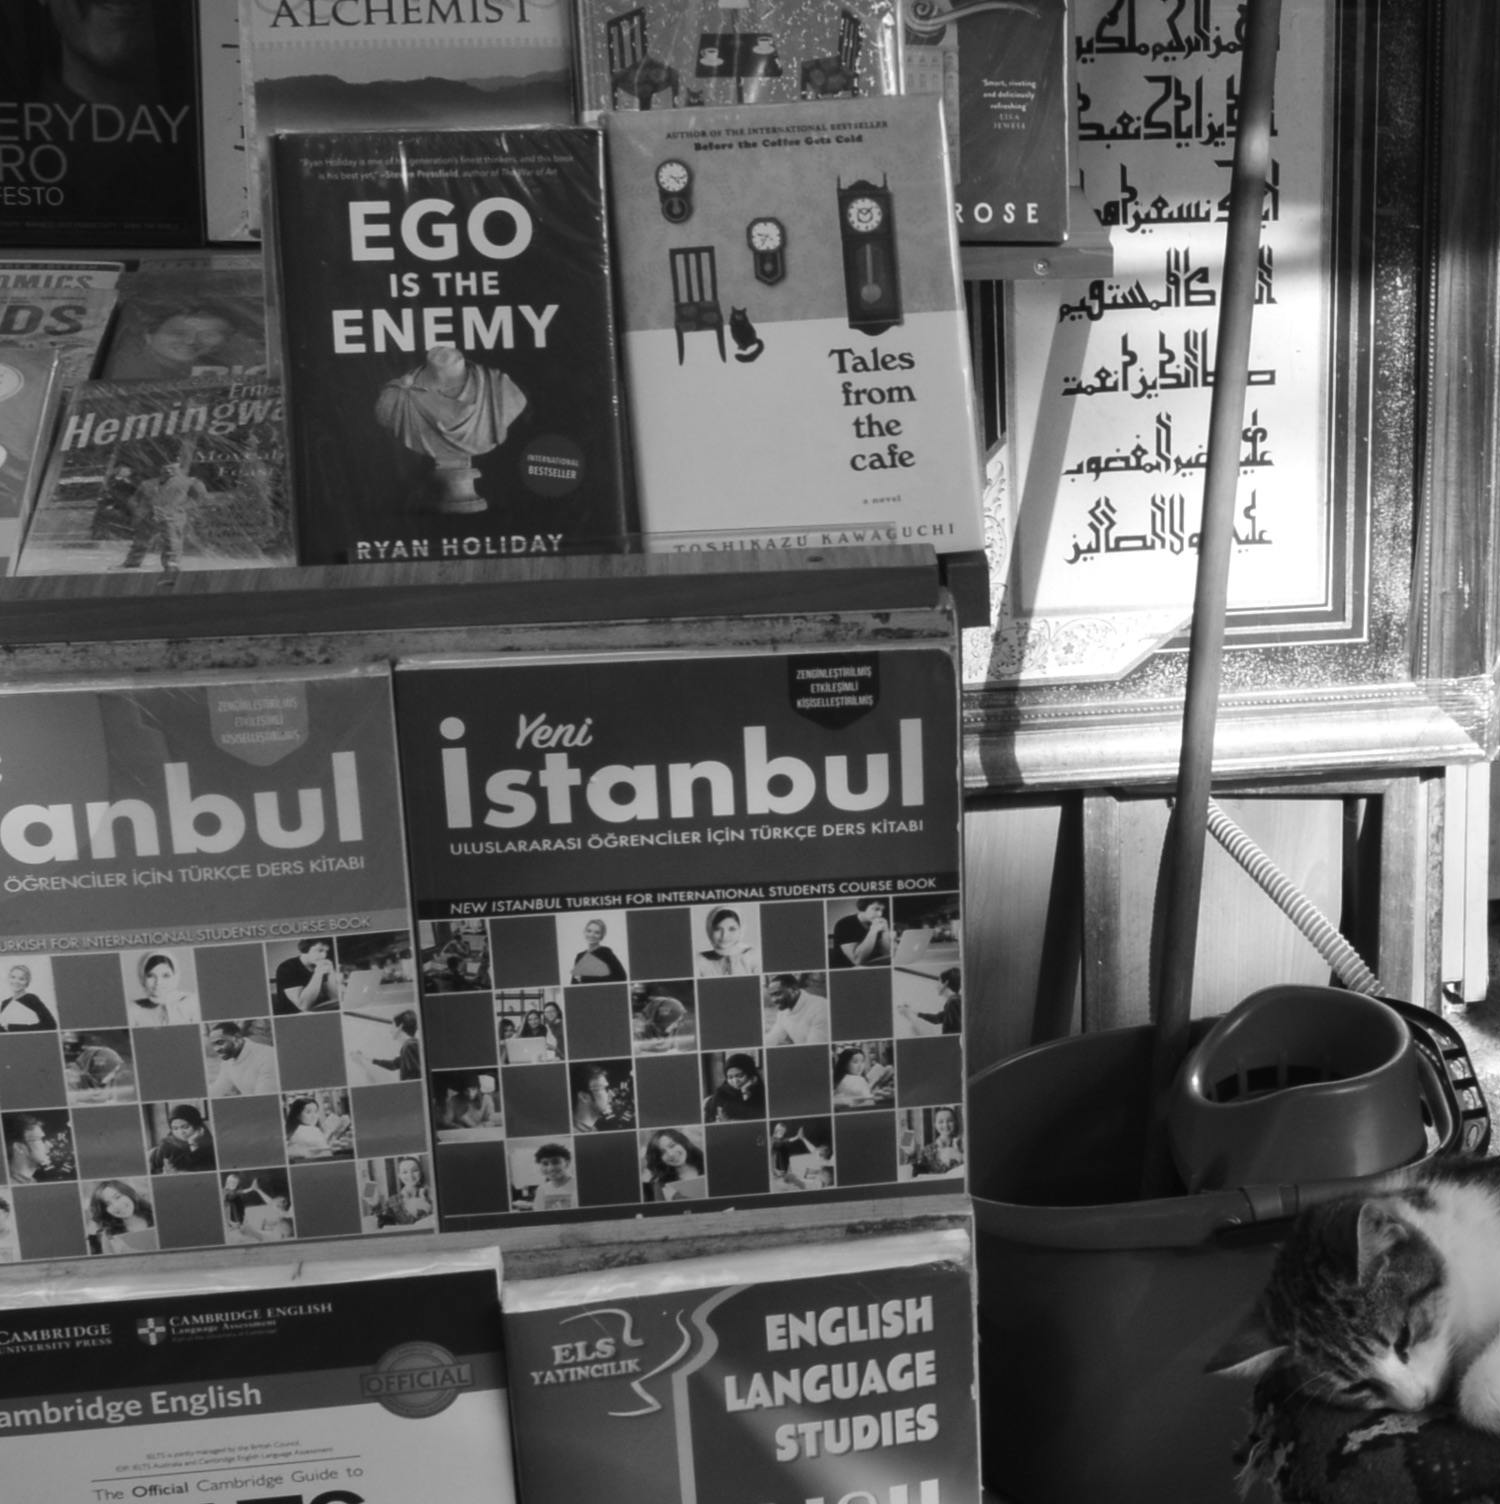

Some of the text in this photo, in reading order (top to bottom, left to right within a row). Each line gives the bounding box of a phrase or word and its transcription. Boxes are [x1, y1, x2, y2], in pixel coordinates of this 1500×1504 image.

[347, 196, 534, 263] EGO
[388, 271, 501, 298] IS THE
[330, 303, 560, 355] ENEMY
[828, 346, 916, 375] Tales
[841, 382, 917, 407] from
[852, 413, 903, 440] the
[849, 443, 916, 472] cafe
[355, 533, 565, 561] RYAN HOLIDAY
[821, 522, 956, 546] KAWAGUCHI
[515, 712, 594, 750] Yeni
[438, 716, 925, 829] istanbul
[0, 750, 364, 865] anbul
[449, 818, 925, 856] ULUSLARARASI ÖĞRENCİLER İÇİN TÜRKÇE DERS KİTABI
[3, 855, 366, 894] ÖĞRENCİLER TÜRKÇE DERS KİTABI
[450, 876, 938, 916] NEW ISTANBUL TURKISH FOR INTERNATIONAL STUDENTS COURSE BOOK
[168, 1301, 334, 1327] CAMBRIDGE ENGLISH
[765, 1295, 936, 1352] ENGLISH
[551, 1337, 616, 1367] ELS
[364, 1365, 470, 1396] OFFICIAL
[529, 1358, 642, 1387] YAYINCILIK
[724, 1349, 938, 1413] LANGUAGE
[150, 1382, 263, 1417] English
[775, 1403, 940, 1463] STUDIES
[131, 1464, 364, 1499] Official Cambridge Guide to
